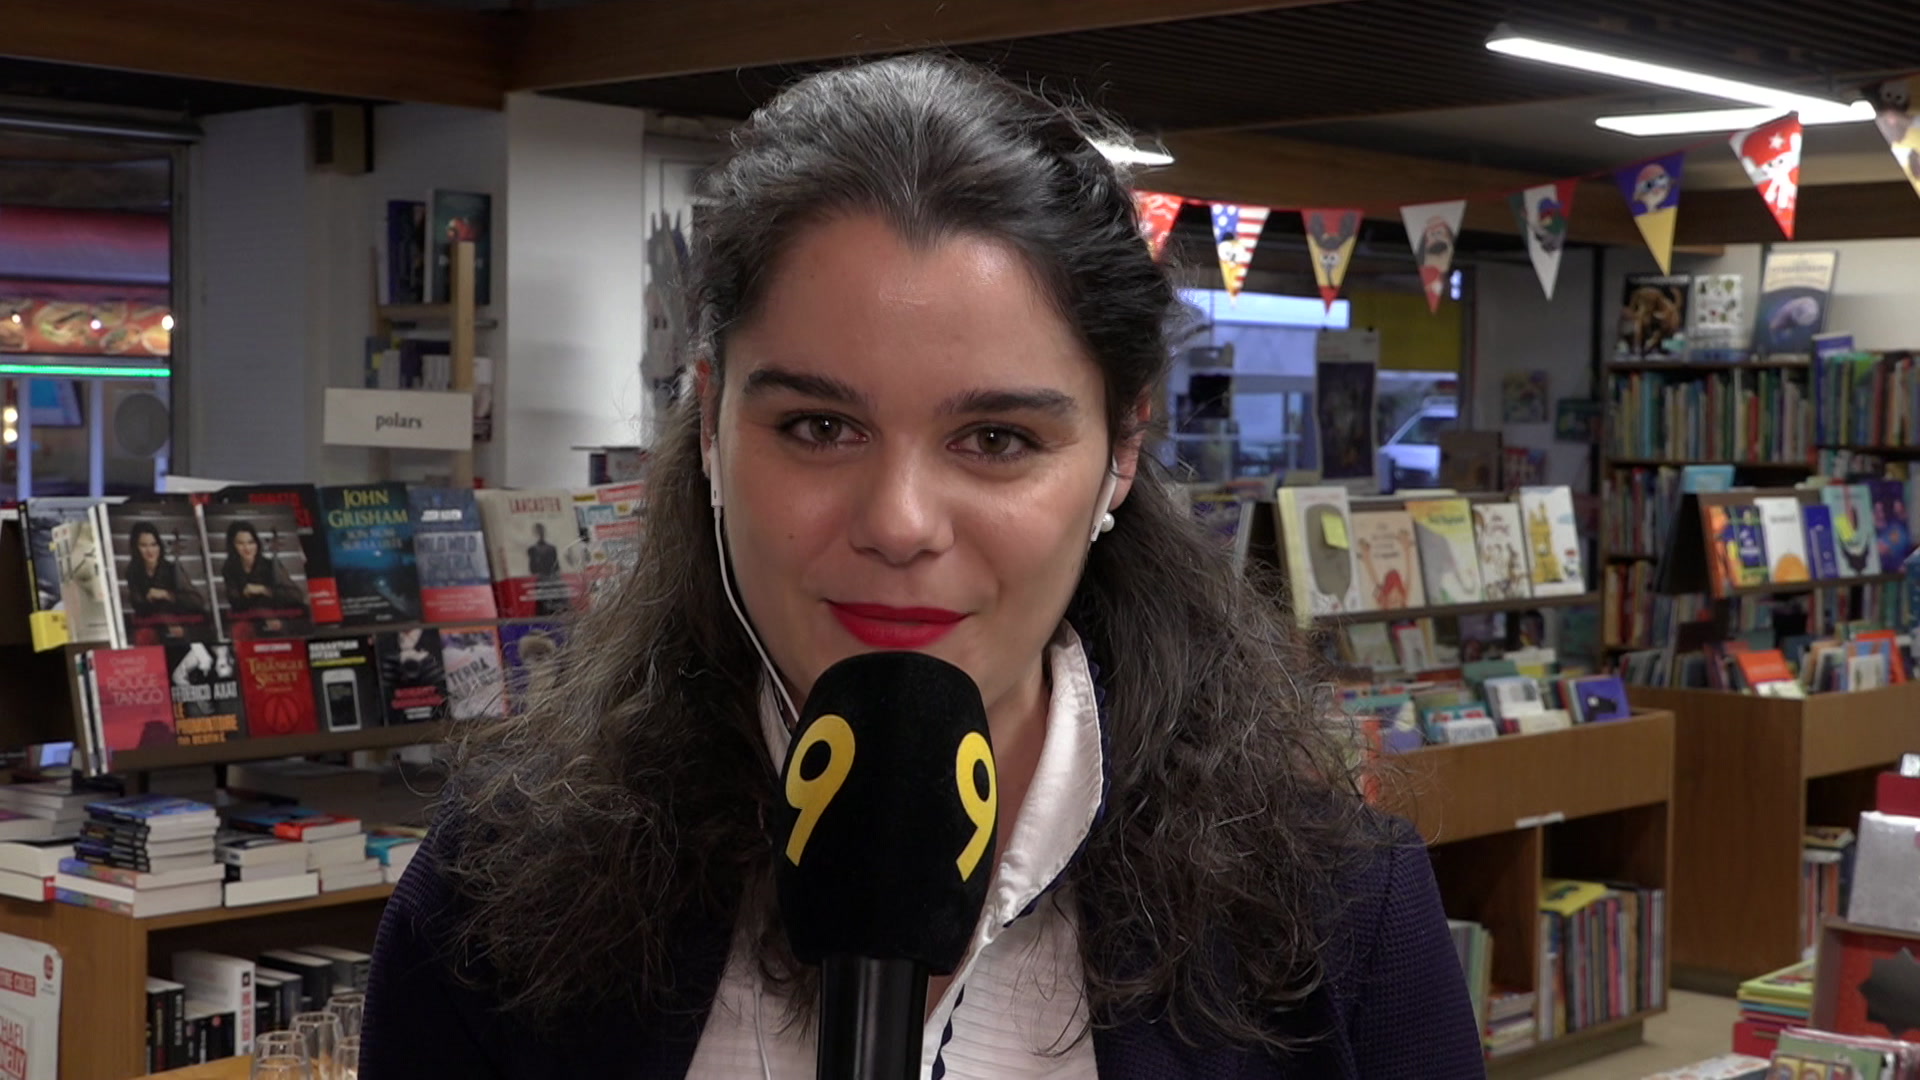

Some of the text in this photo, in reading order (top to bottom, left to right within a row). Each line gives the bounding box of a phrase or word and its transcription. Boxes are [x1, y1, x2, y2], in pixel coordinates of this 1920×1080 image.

[375, 411, 422, 432] polars
[343, 488, 389, 510] JOHN
[508, 496, 562, 514] LANCASTER
[328, 509, 409, 529] GRISHAM
[245, 657, 304, 676] TRIANGLE
[449, 656, 490, 687] TERRA
[106, 673, 159, 690] ROUGE
[255, 671, 298, 690] SECRET
[112, 688, 164, 706] TANGO
[786, 714, 856, 867] 9
[956, 732, 997, 882] 9
